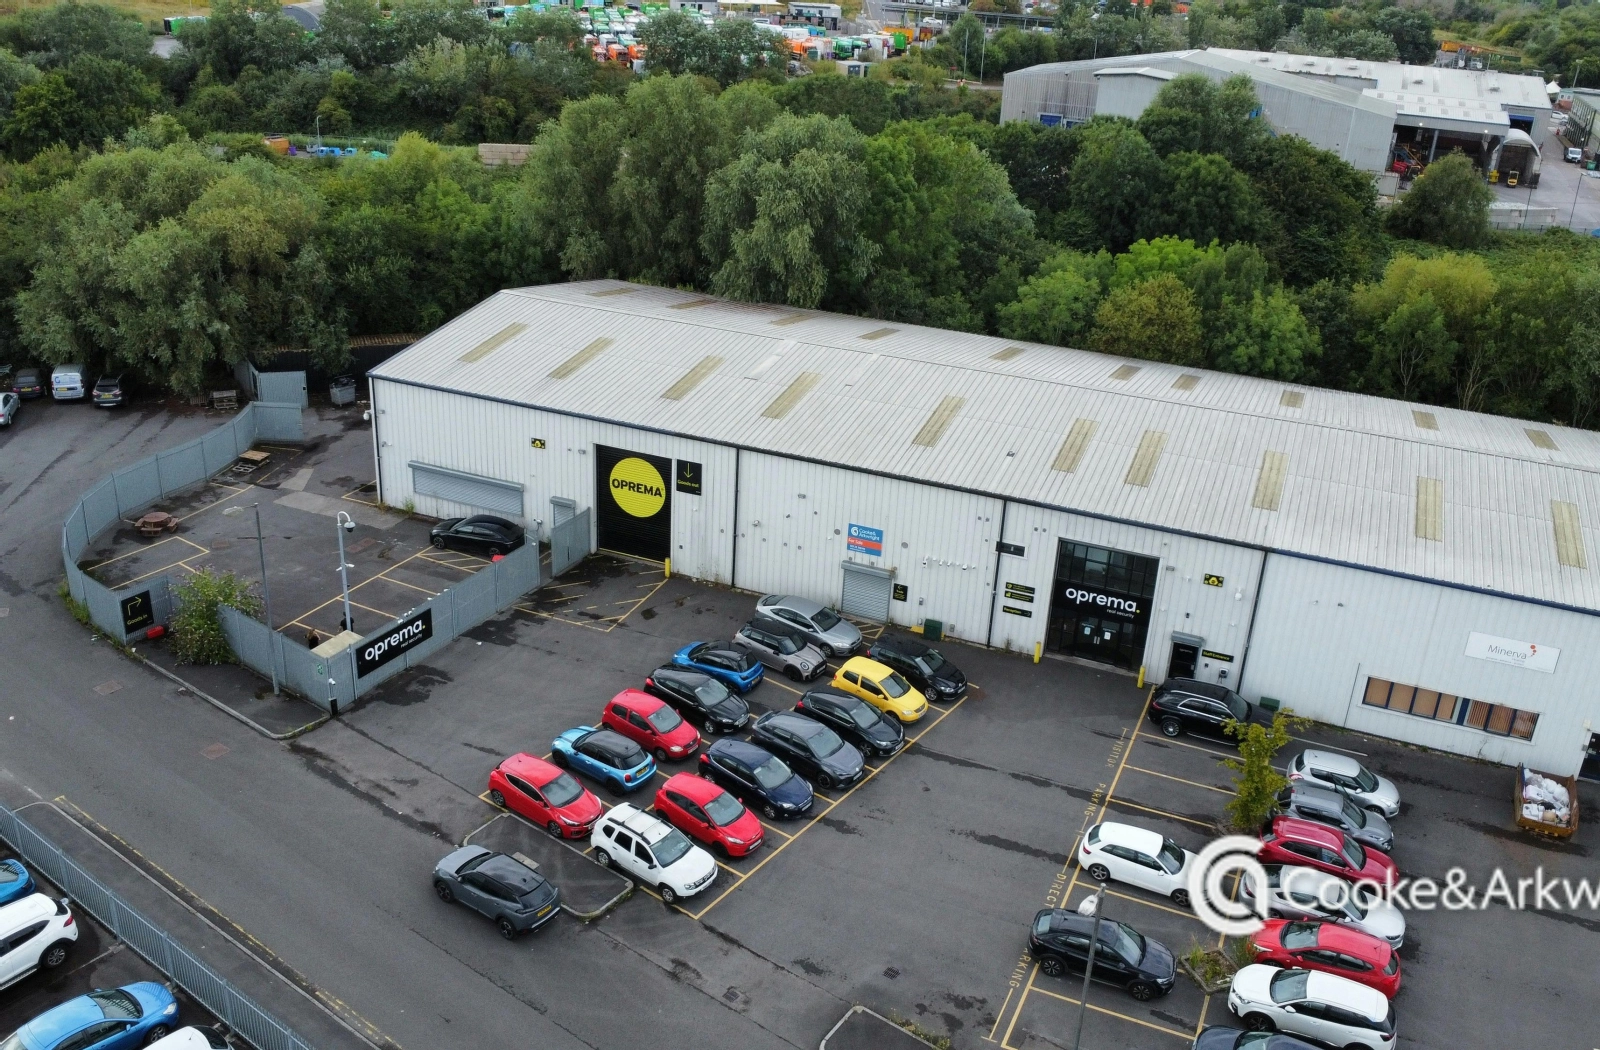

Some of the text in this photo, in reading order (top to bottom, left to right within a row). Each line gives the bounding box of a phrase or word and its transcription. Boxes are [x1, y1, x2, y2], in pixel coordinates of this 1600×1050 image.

[611, 478, 663, 498] OPREMA
[127, 616, 142, 625] Goods
[1116, 611, 1134, 619] security
[1487, 644, 1527, 660] Minerva
[1084, 739, 1124, 817] VISITOR PARKING
[1008, 873, 1067, 988] DIRECT ARKING
